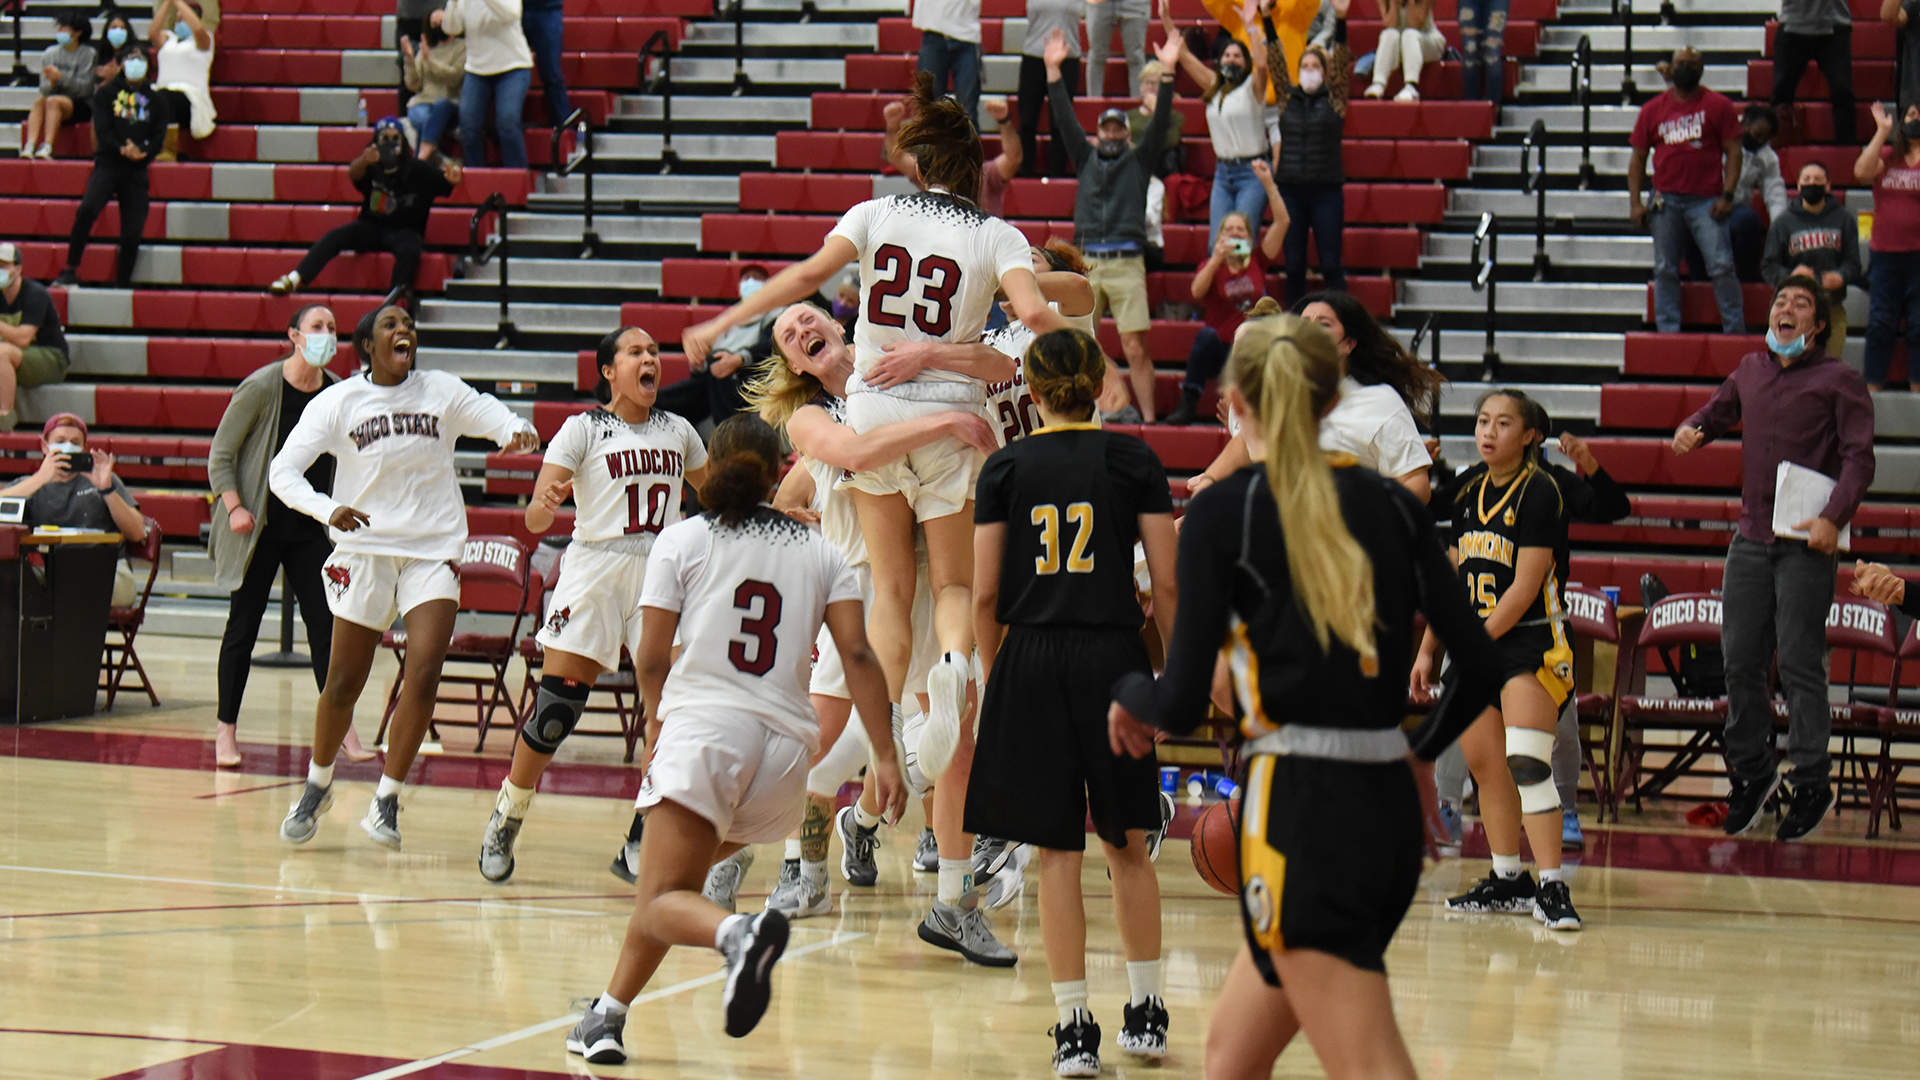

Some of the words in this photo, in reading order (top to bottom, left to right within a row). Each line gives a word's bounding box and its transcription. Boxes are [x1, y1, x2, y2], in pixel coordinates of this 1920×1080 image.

[868, 243, 962, 337] 23
[391, 412, 440, 441] STATE
[997, 393, 1045, 444] 20
[605, 448, 684, 480] WILDCATS
[623, 483, 671, 535] 10
[1030, 501, 1094, 576] 32
[484, 540, 520, 572] STATE
[1564, 590, 1607, 624] STATE
[1652, 599, 1695, 630] CHICO
[1697, 599, 1724, 625] STA
[1842, 603, 1887, 637] STATE
[728, 578, 783, 677] 3
